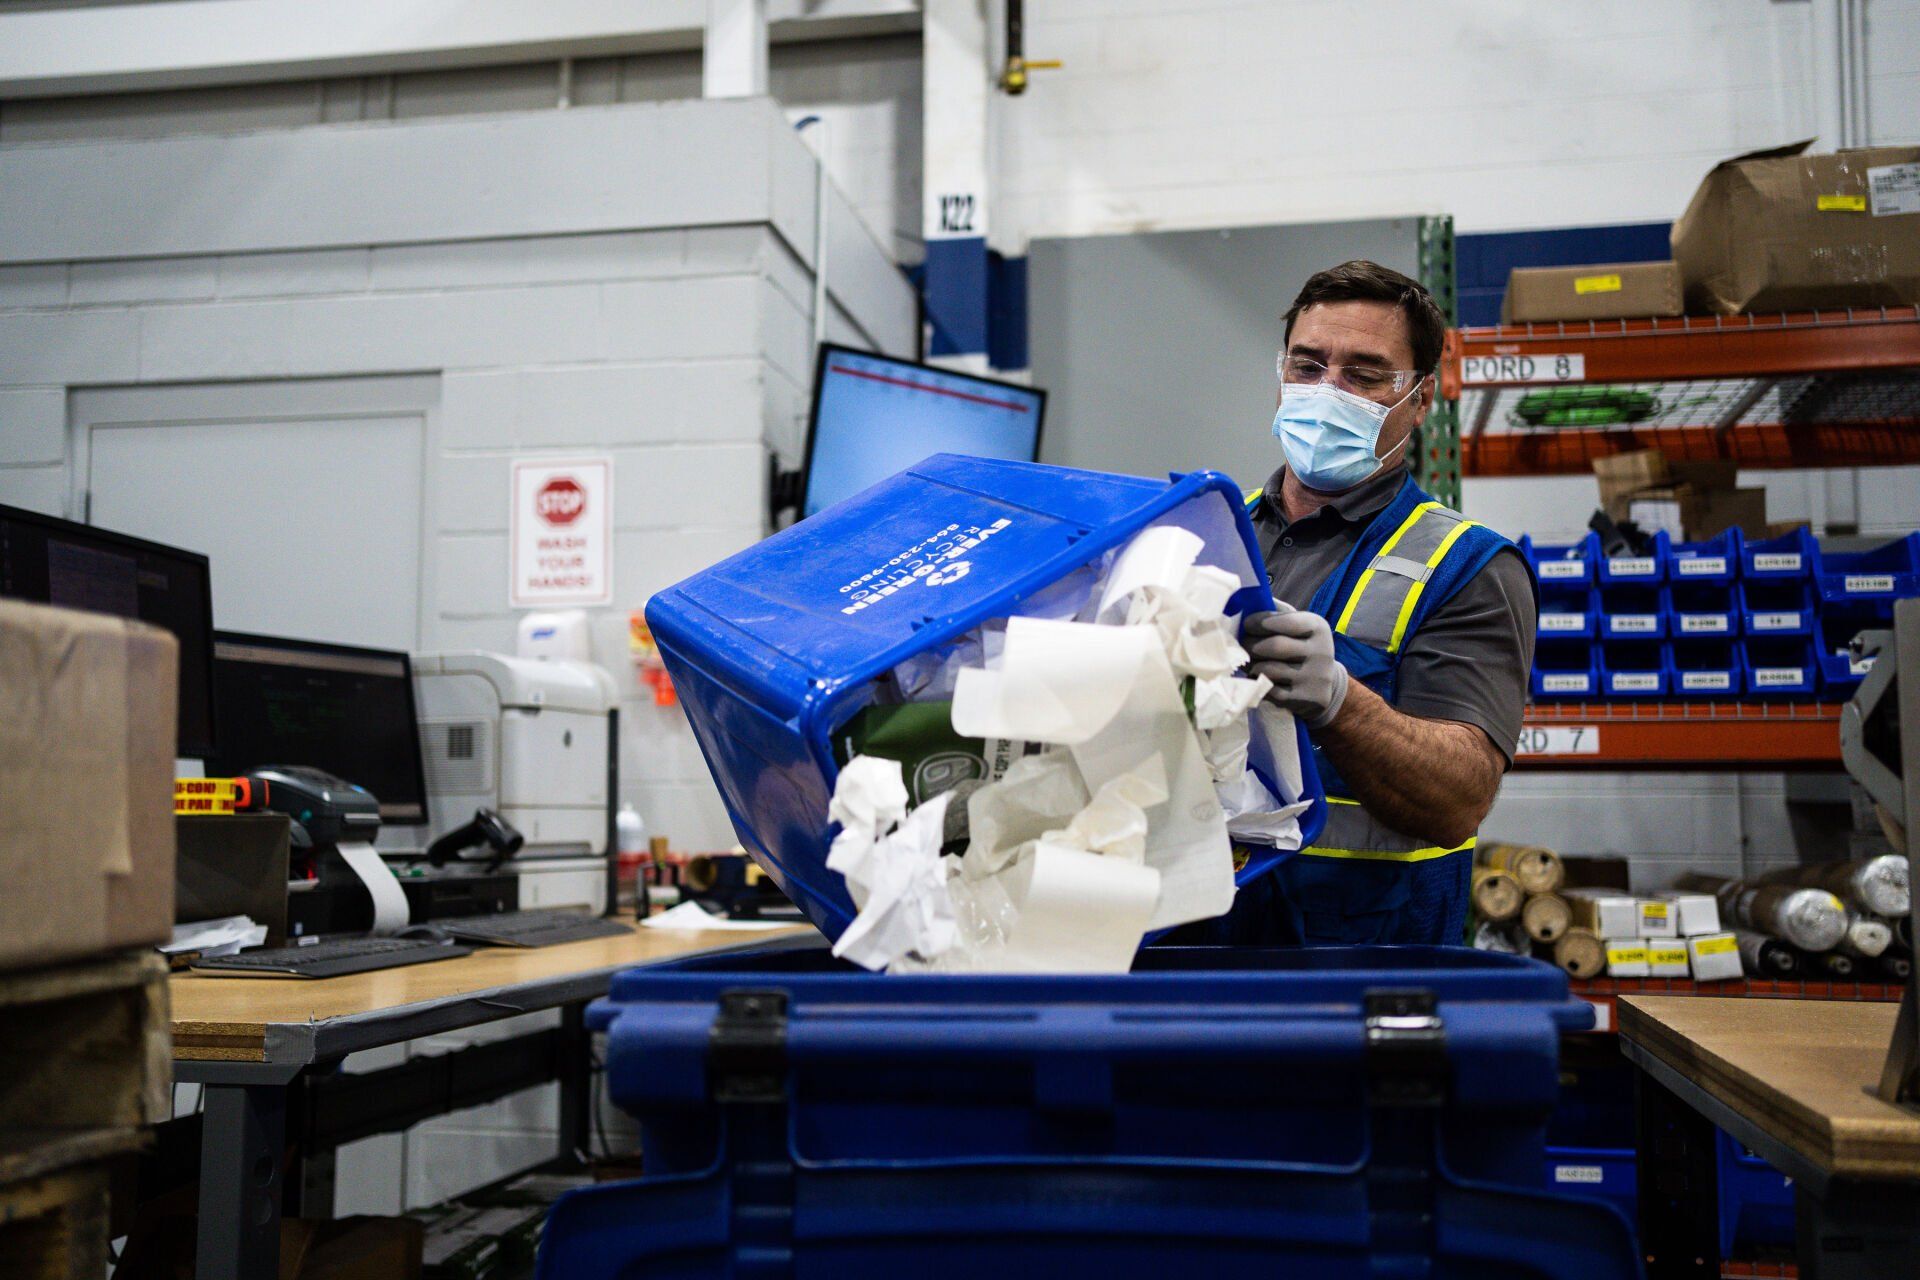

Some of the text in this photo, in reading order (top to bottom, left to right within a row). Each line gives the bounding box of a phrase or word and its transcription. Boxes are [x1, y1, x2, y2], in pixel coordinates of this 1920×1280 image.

[1464, 354, 1572, 382] PORD 8
[839, 523, 960, 593] 864-230-9800
[841, 518, 1012, 615] EVER-GREEN
[850, 526, 981, 600] RECYCLING
[1569, 727, 1584, 752] 7
